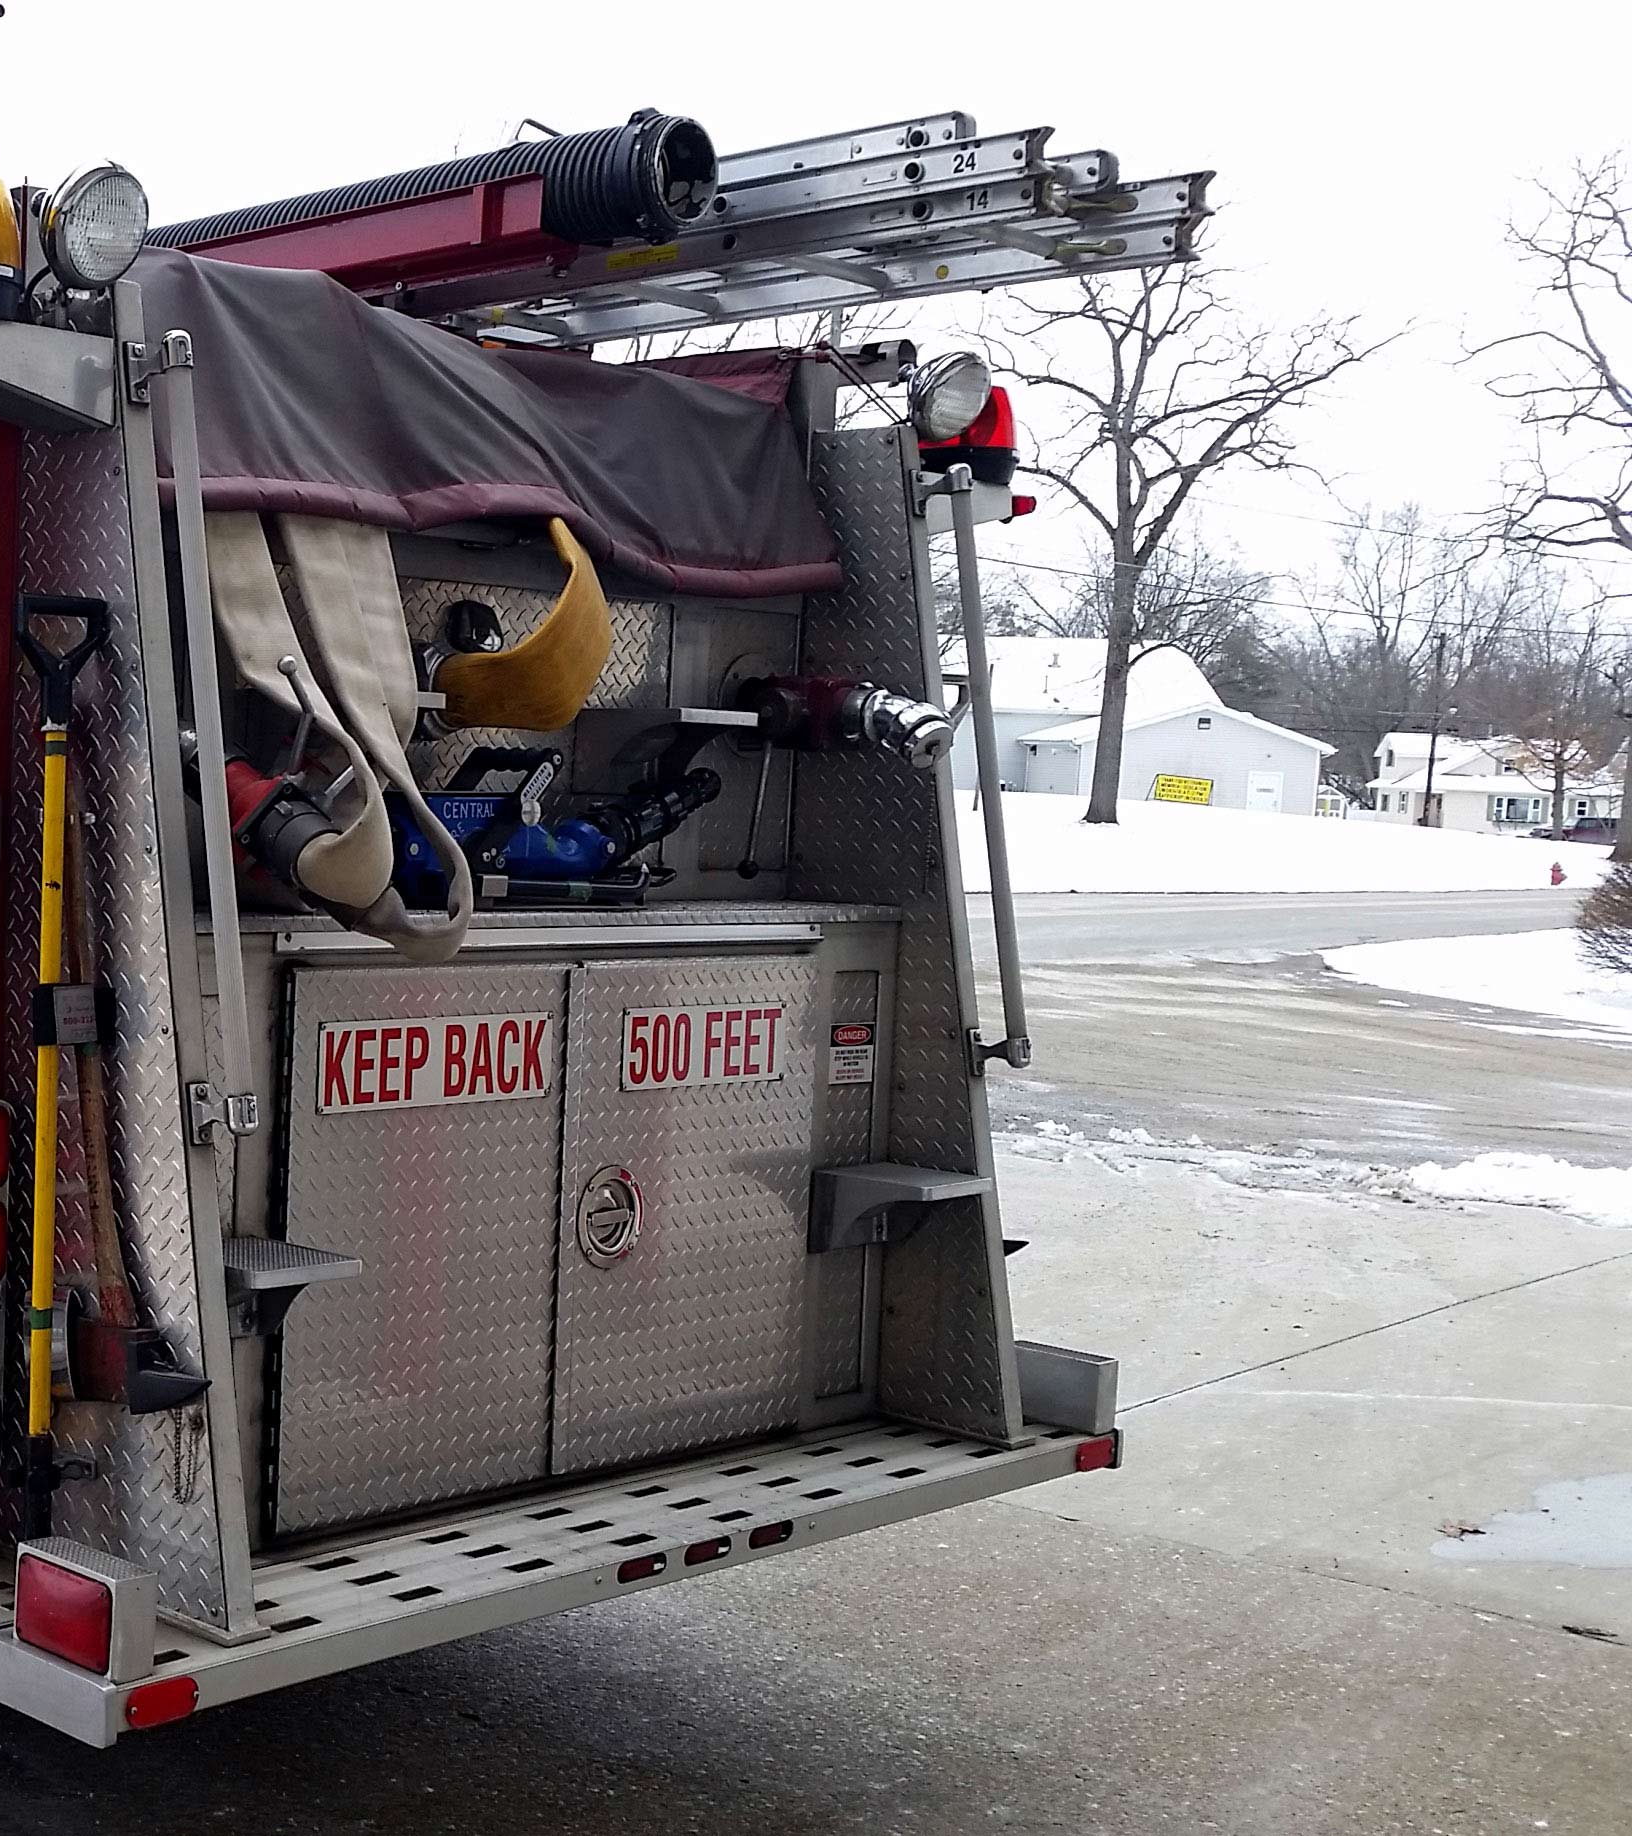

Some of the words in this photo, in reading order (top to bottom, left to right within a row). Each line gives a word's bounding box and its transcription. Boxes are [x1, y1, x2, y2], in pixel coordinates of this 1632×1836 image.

[953, 152, 976, 173] 24
[966, 190, 989, 210] 14
[443, 801, 495, 819] CENTRAL
[838, 1030, 867, 1041] DANGER
[629, 1012, 692, 1085] 500
[703, 1008, 783, 1078] FEET
[323, 1026, 430, 1107] KEEP
[443, 1019, 546, 1098] BACK
